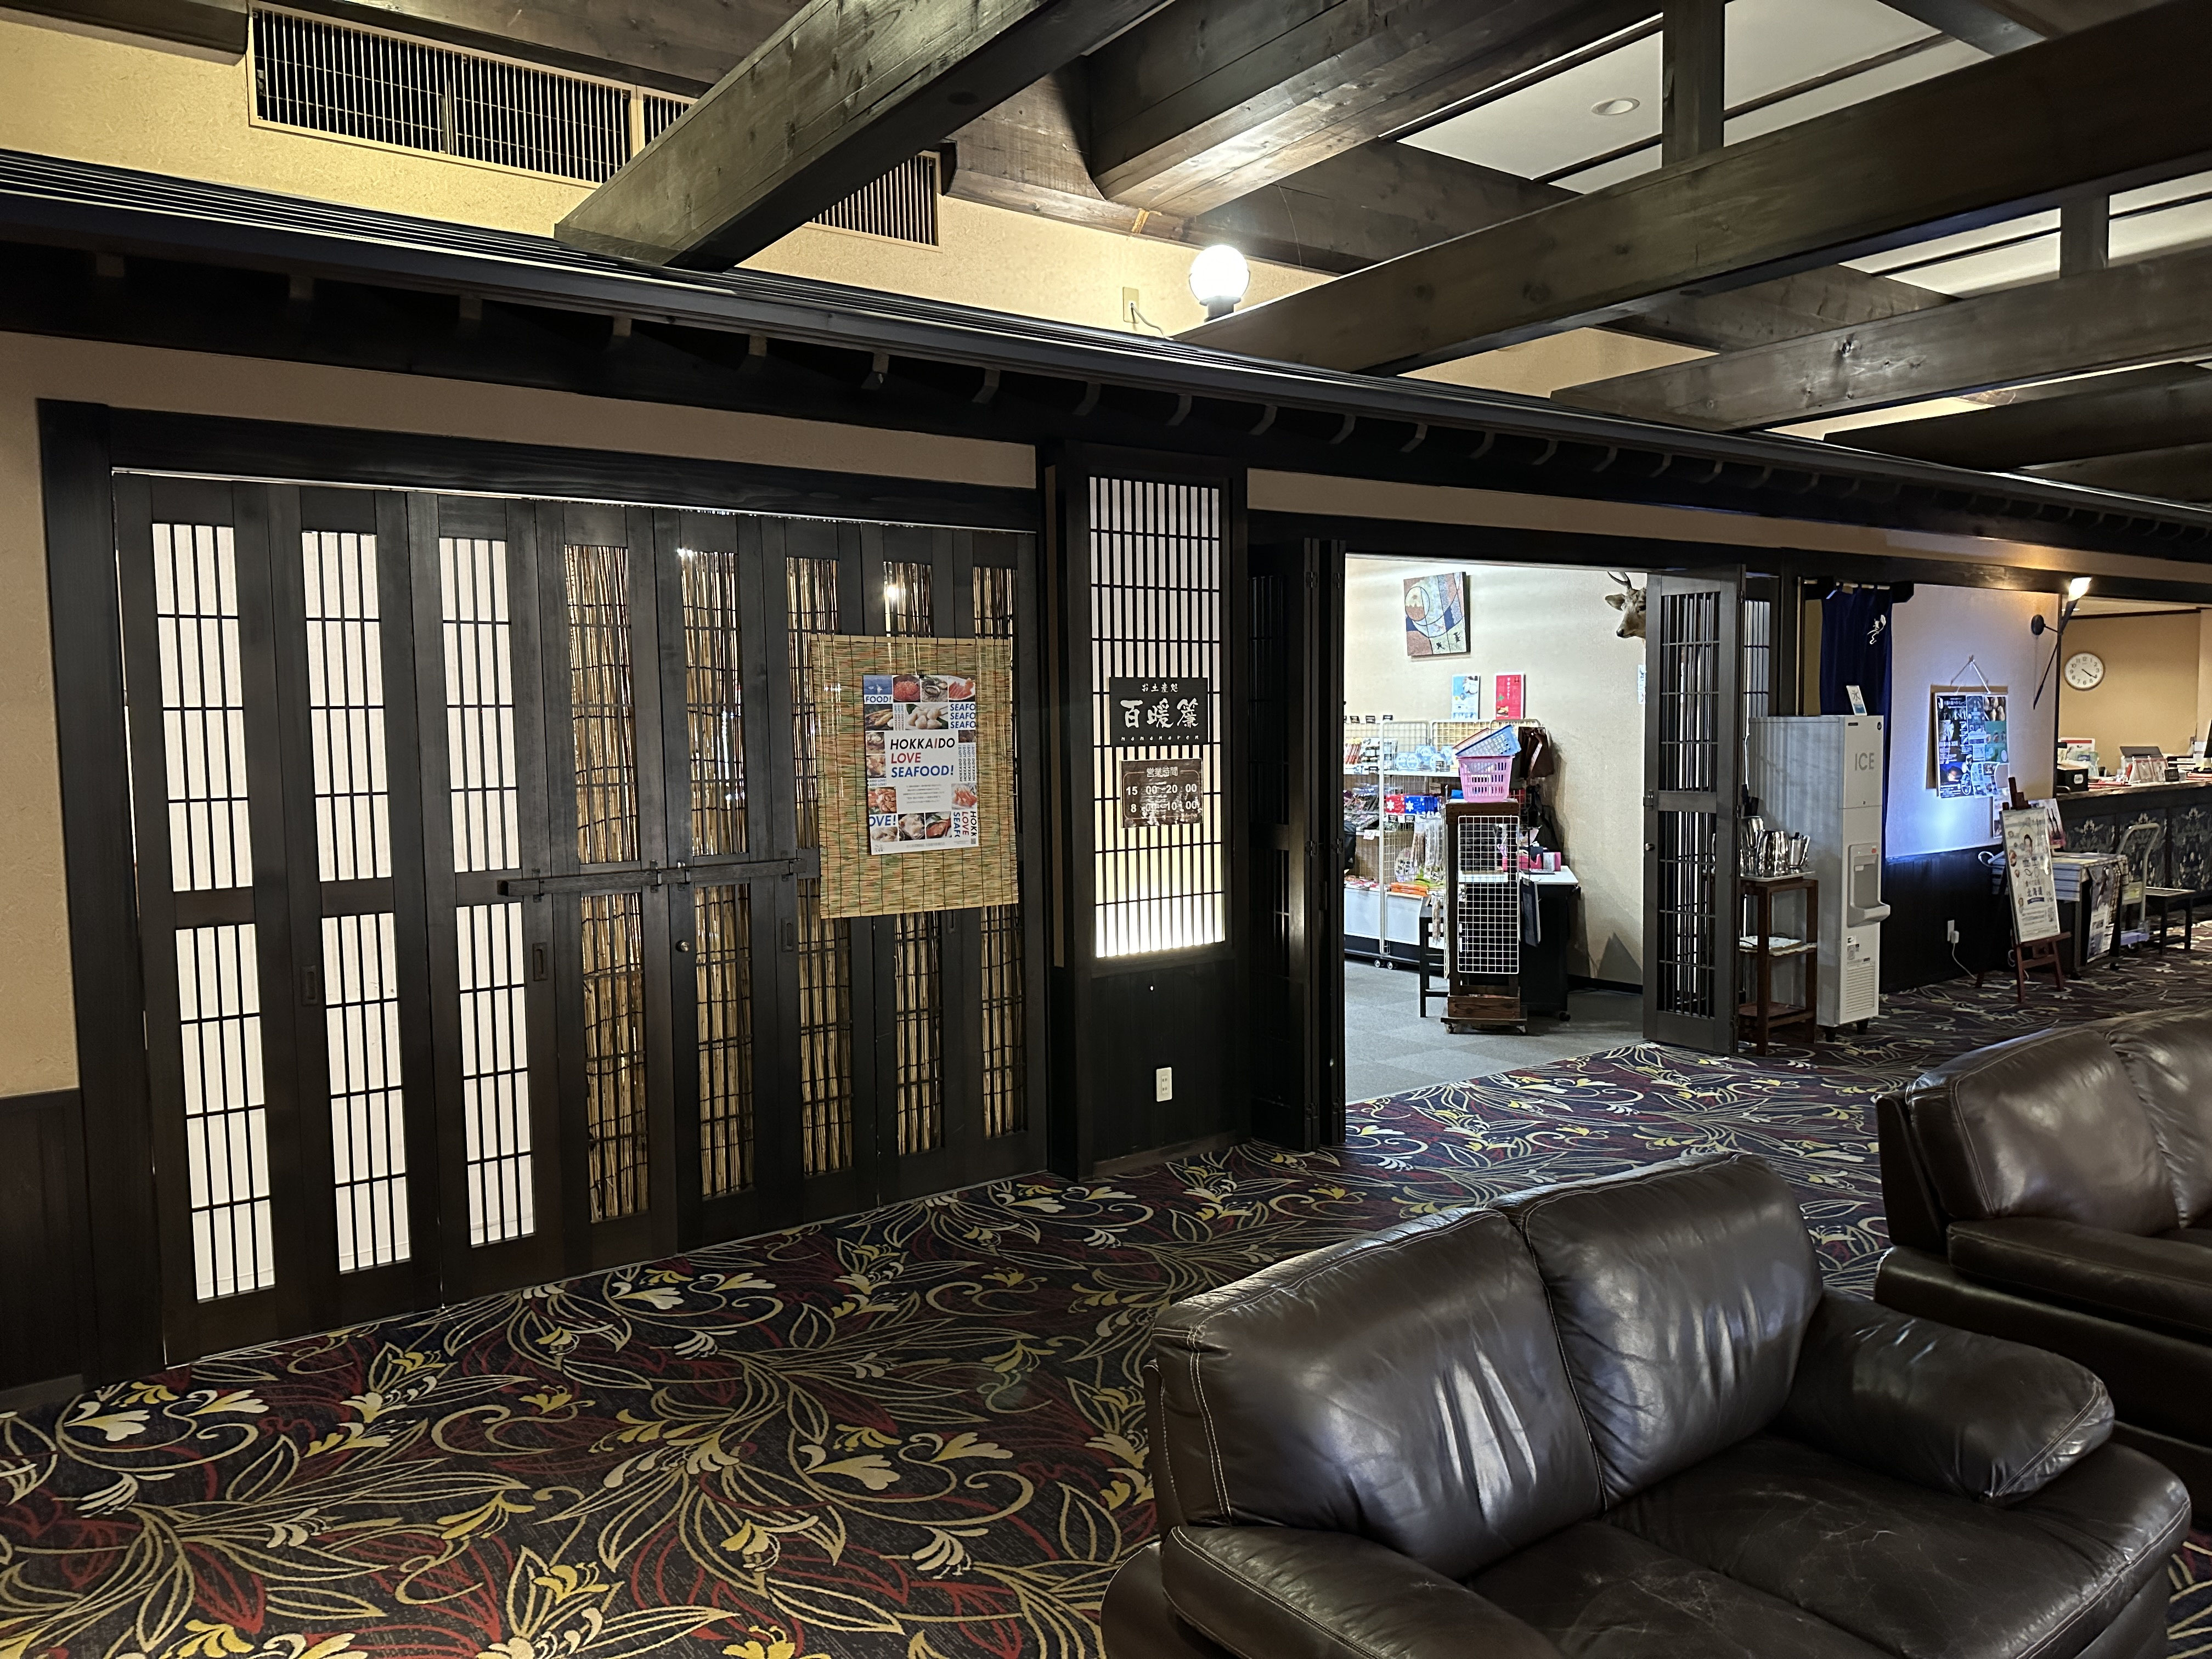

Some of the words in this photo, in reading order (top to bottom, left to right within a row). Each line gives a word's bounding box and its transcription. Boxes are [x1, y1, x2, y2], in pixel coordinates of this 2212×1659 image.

[890, 738, 955, 749] HOKKAIDO
[891, 753, 921, 764] LOVE
[1855, 753, 1875, 771] ICE
[891, 765, 953, 777] SEAFOOD!
[1147, 767, 1178, 777] 営業時間
[1126, 786, 1138, 795] 15
[1166, 785, 1178, 793] 20
[1186, 783, 1197, 792] 00
[1131, 804, 1137, 812] 8
[1186, 801, 1197, 809] 00
